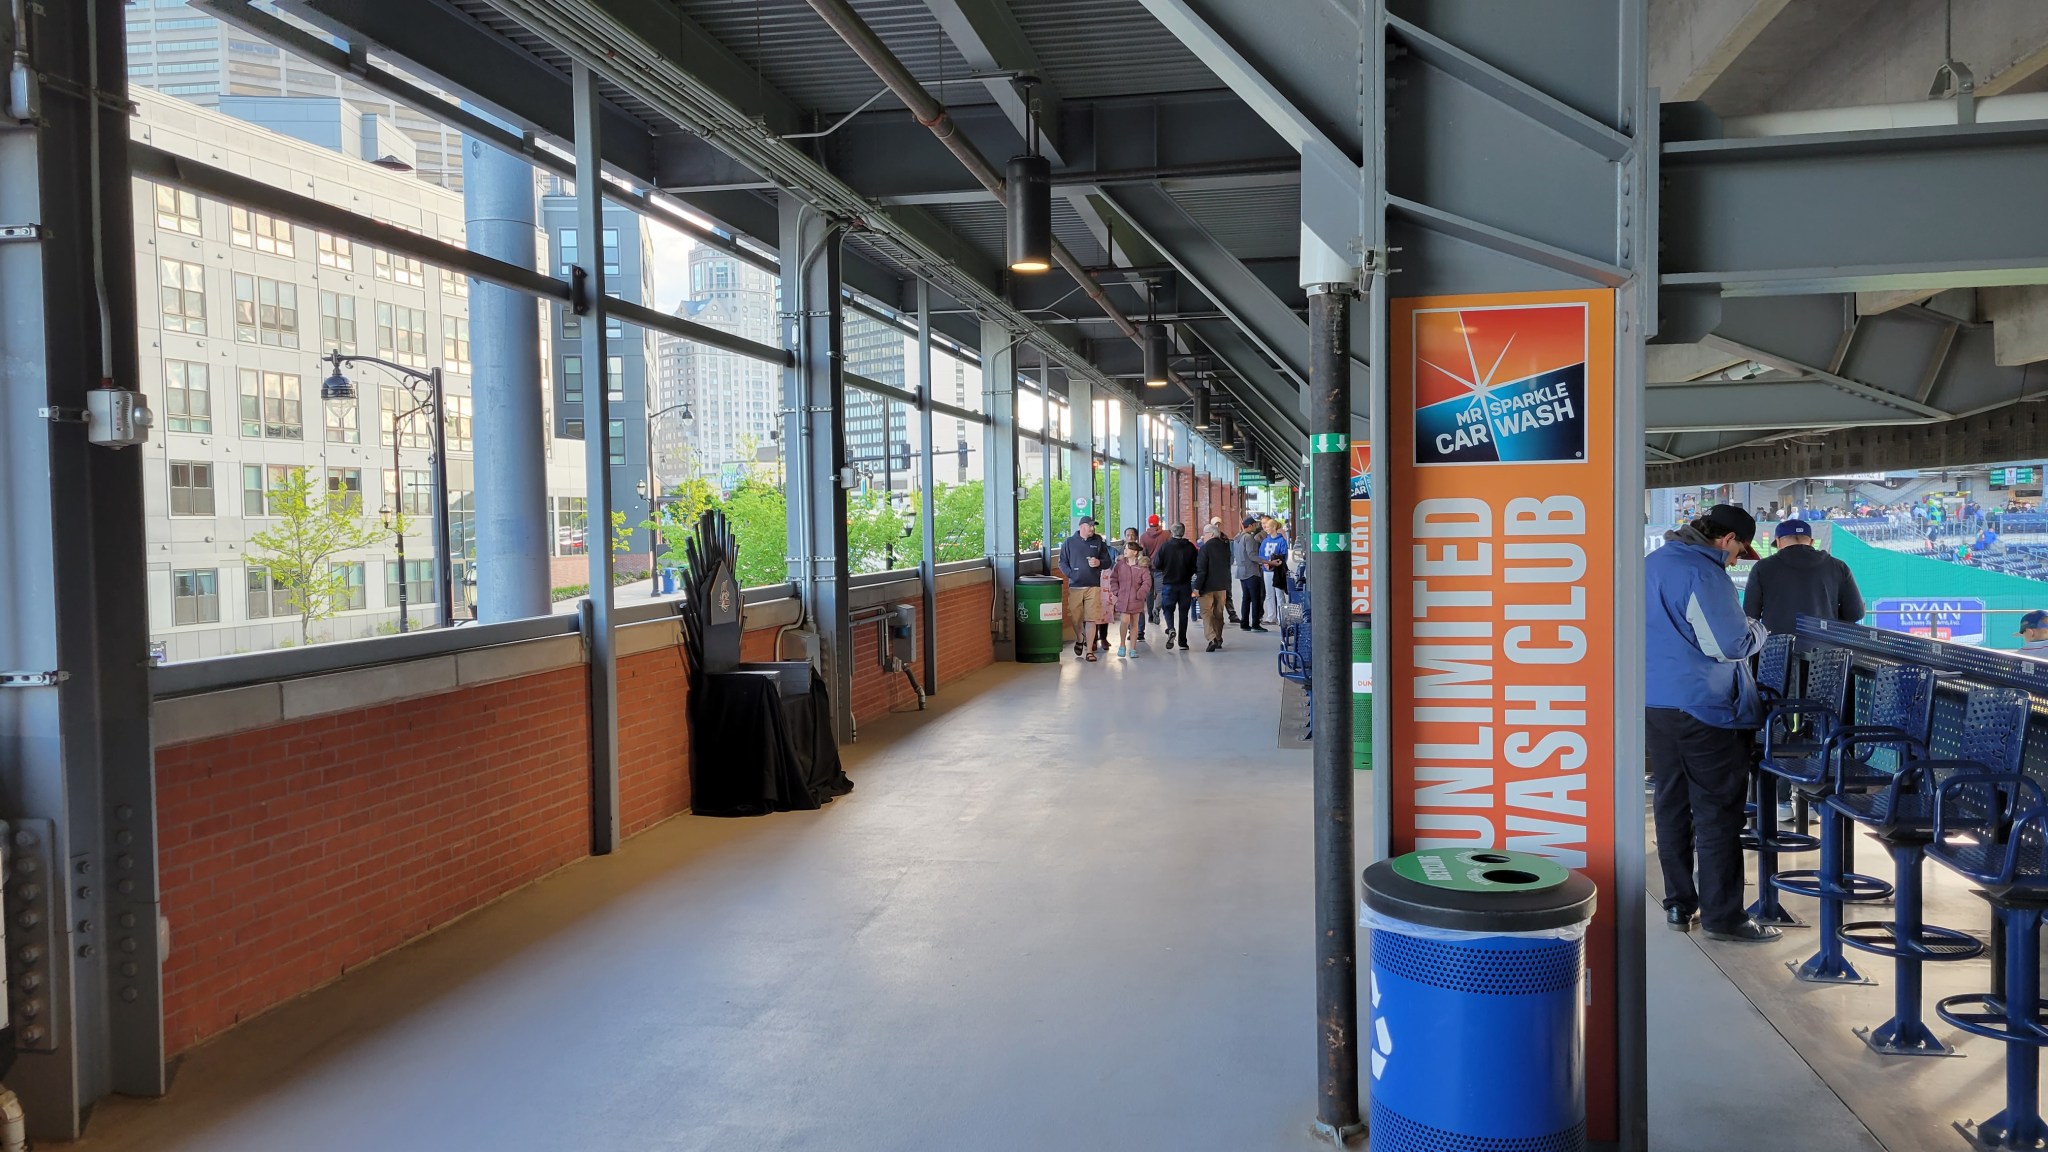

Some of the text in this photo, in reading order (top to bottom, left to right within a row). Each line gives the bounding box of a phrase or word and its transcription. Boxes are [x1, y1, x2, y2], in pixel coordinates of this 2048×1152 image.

[1435, 398, 1575, 454] CAR WASH
[1455, 382, 1569, 426] MR SPARKLE
[1900, 602, 1961, 620] RYAN
[1412, 497, 1496, 851] UNLIMITED
[1503, 494, 1588, 869] WASH CLUB
